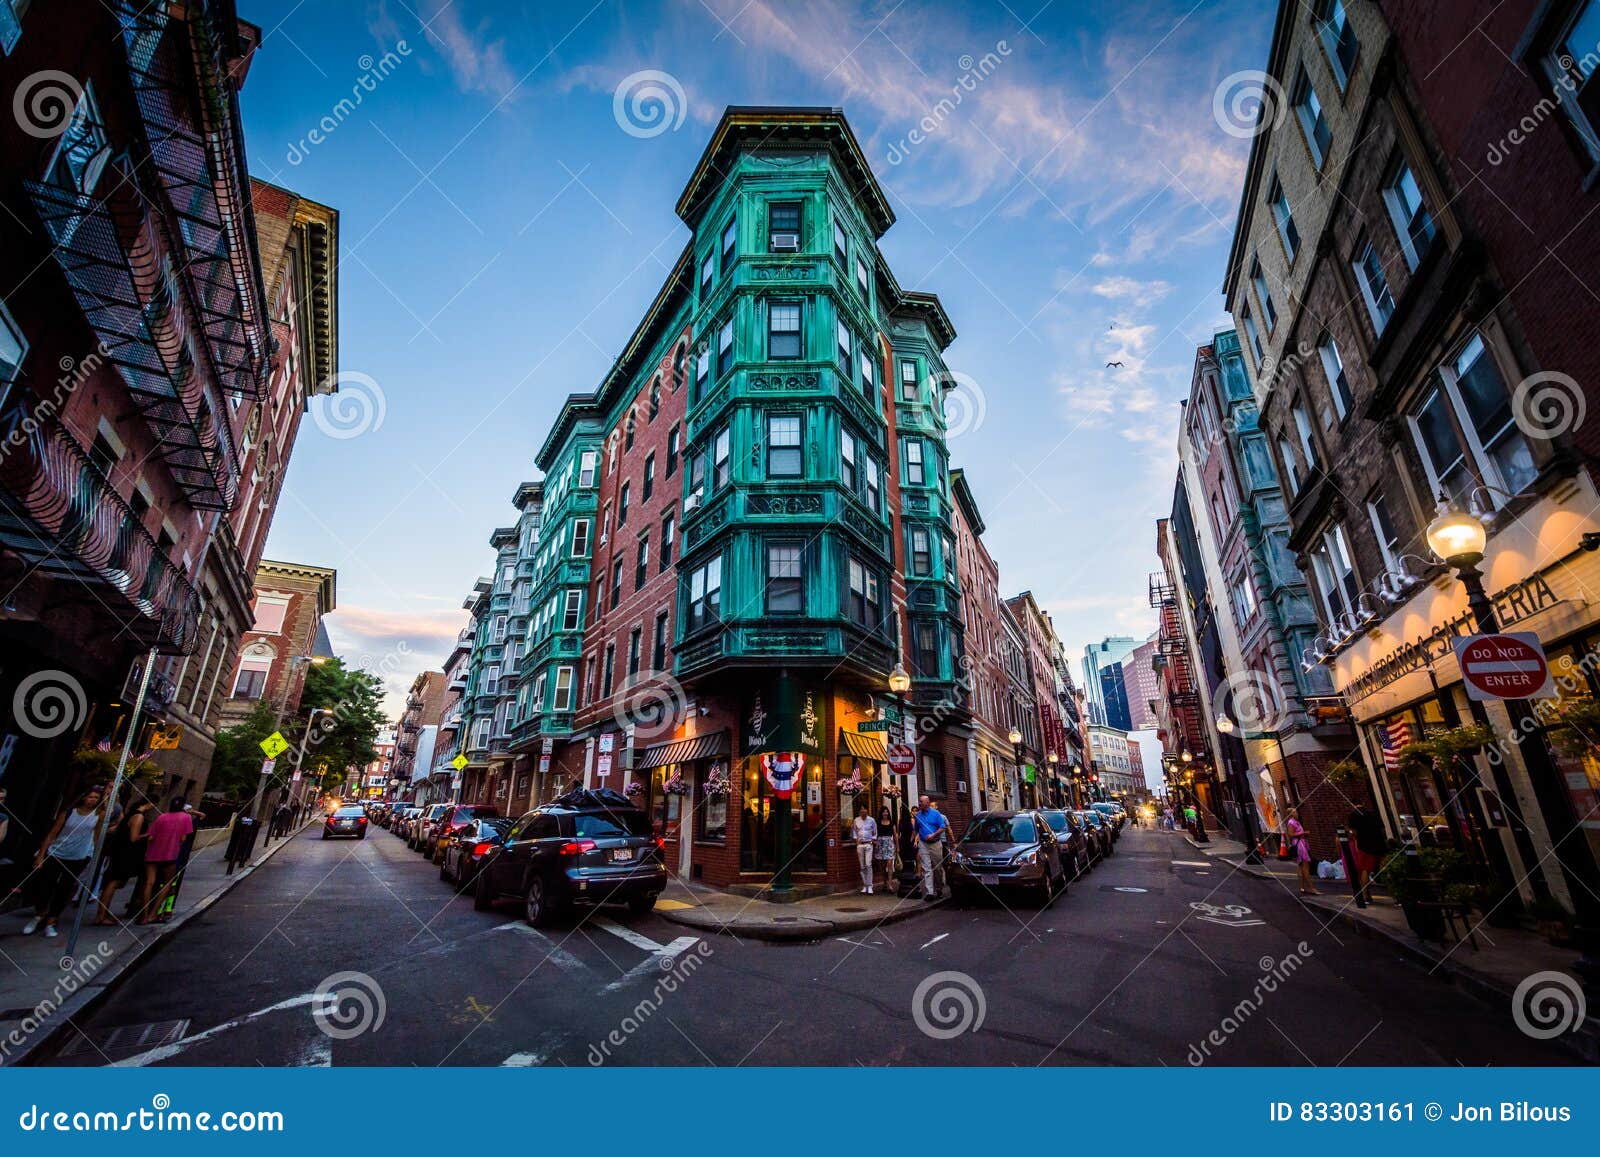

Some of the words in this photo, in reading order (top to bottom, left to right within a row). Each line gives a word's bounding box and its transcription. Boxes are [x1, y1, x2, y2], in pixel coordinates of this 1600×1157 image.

[1472, 648, 1492, 659] DO
[1497, 647, 1524, 658] NOT
[1485, 675, 1532, 686] ENTER
